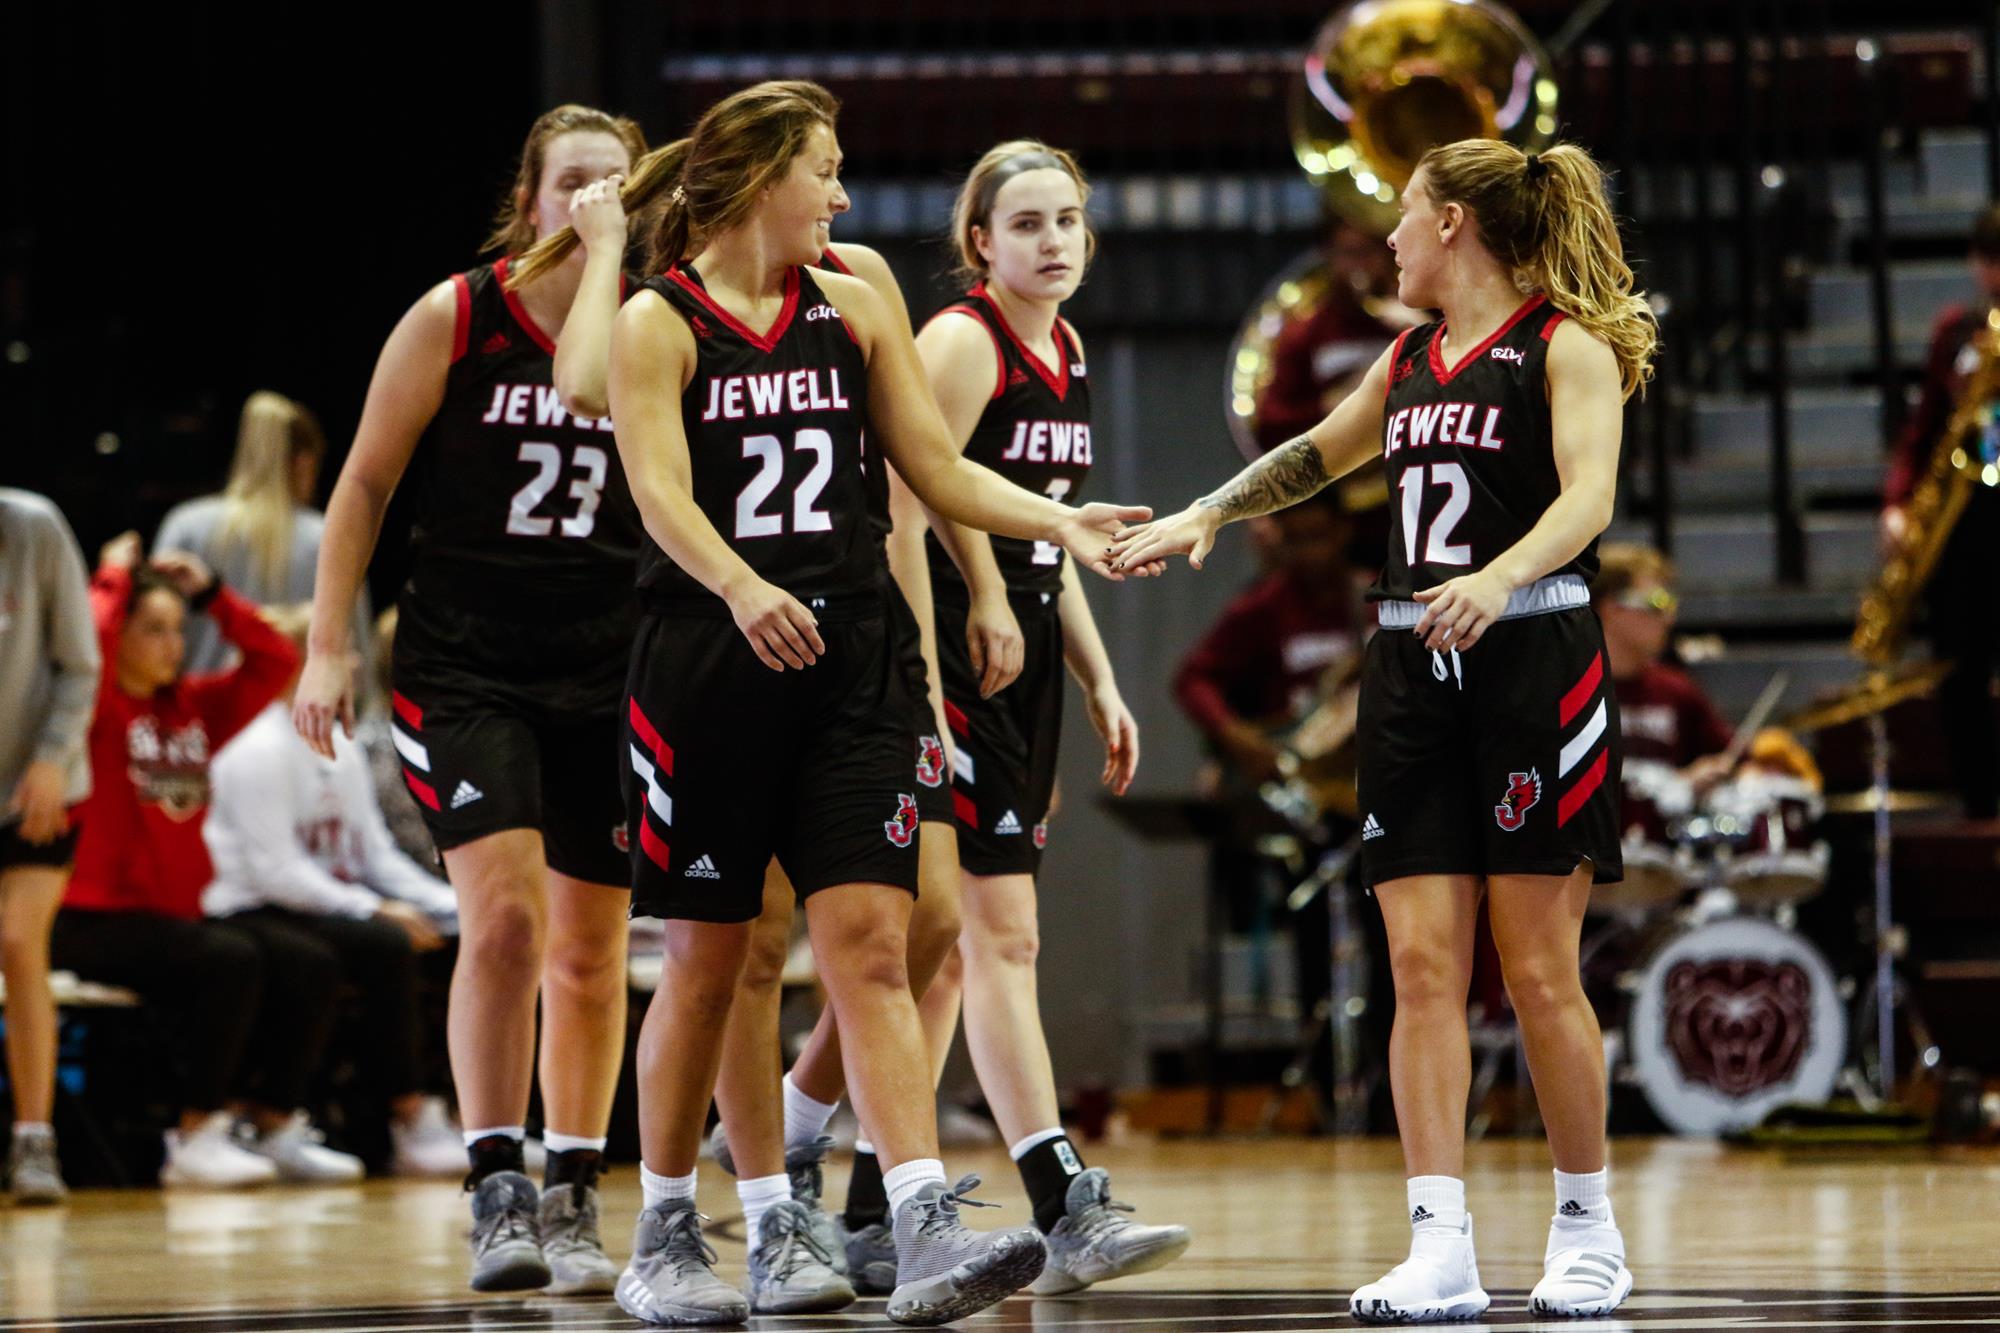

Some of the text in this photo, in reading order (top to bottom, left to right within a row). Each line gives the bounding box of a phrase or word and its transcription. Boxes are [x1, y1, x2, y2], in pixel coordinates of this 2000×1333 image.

[481, 383, 615, 432] JEW
[702, 368, 849, 422] JEWELL
[506, 441, 608, 538] 23
[734, 428, 834, 539] 22
[1398, 462, 1472, 567] 12
[684, 868, 721, 880] adidas
